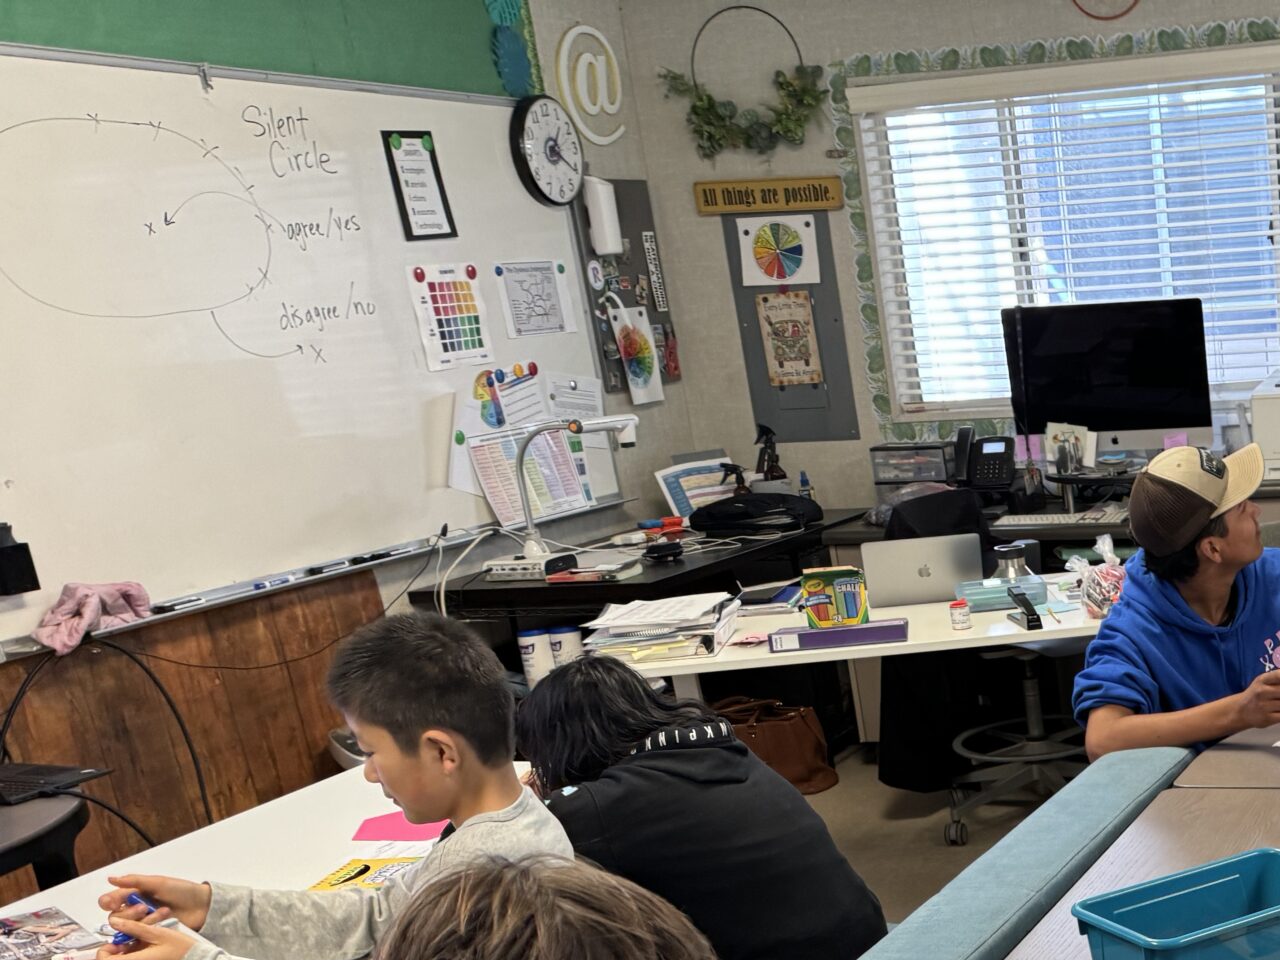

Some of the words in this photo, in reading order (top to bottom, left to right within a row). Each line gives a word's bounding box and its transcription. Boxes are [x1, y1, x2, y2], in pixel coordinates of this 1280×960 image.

[556, 24, 626, 146] @
[540, 103, 549, 117] 12
[241, 105, 309, 140] Silent
[565, 121, 571, 135] 2
[572, 141, 578, 155] 3
[269, 141, 338, 178] Circle
[546, 182, 552, 196] 7
[702, 188, 718, 207] All
[721, 186, 757, 208] things
[761, 187, 779, 204] are
[784, 183, 835, 206] possible.
